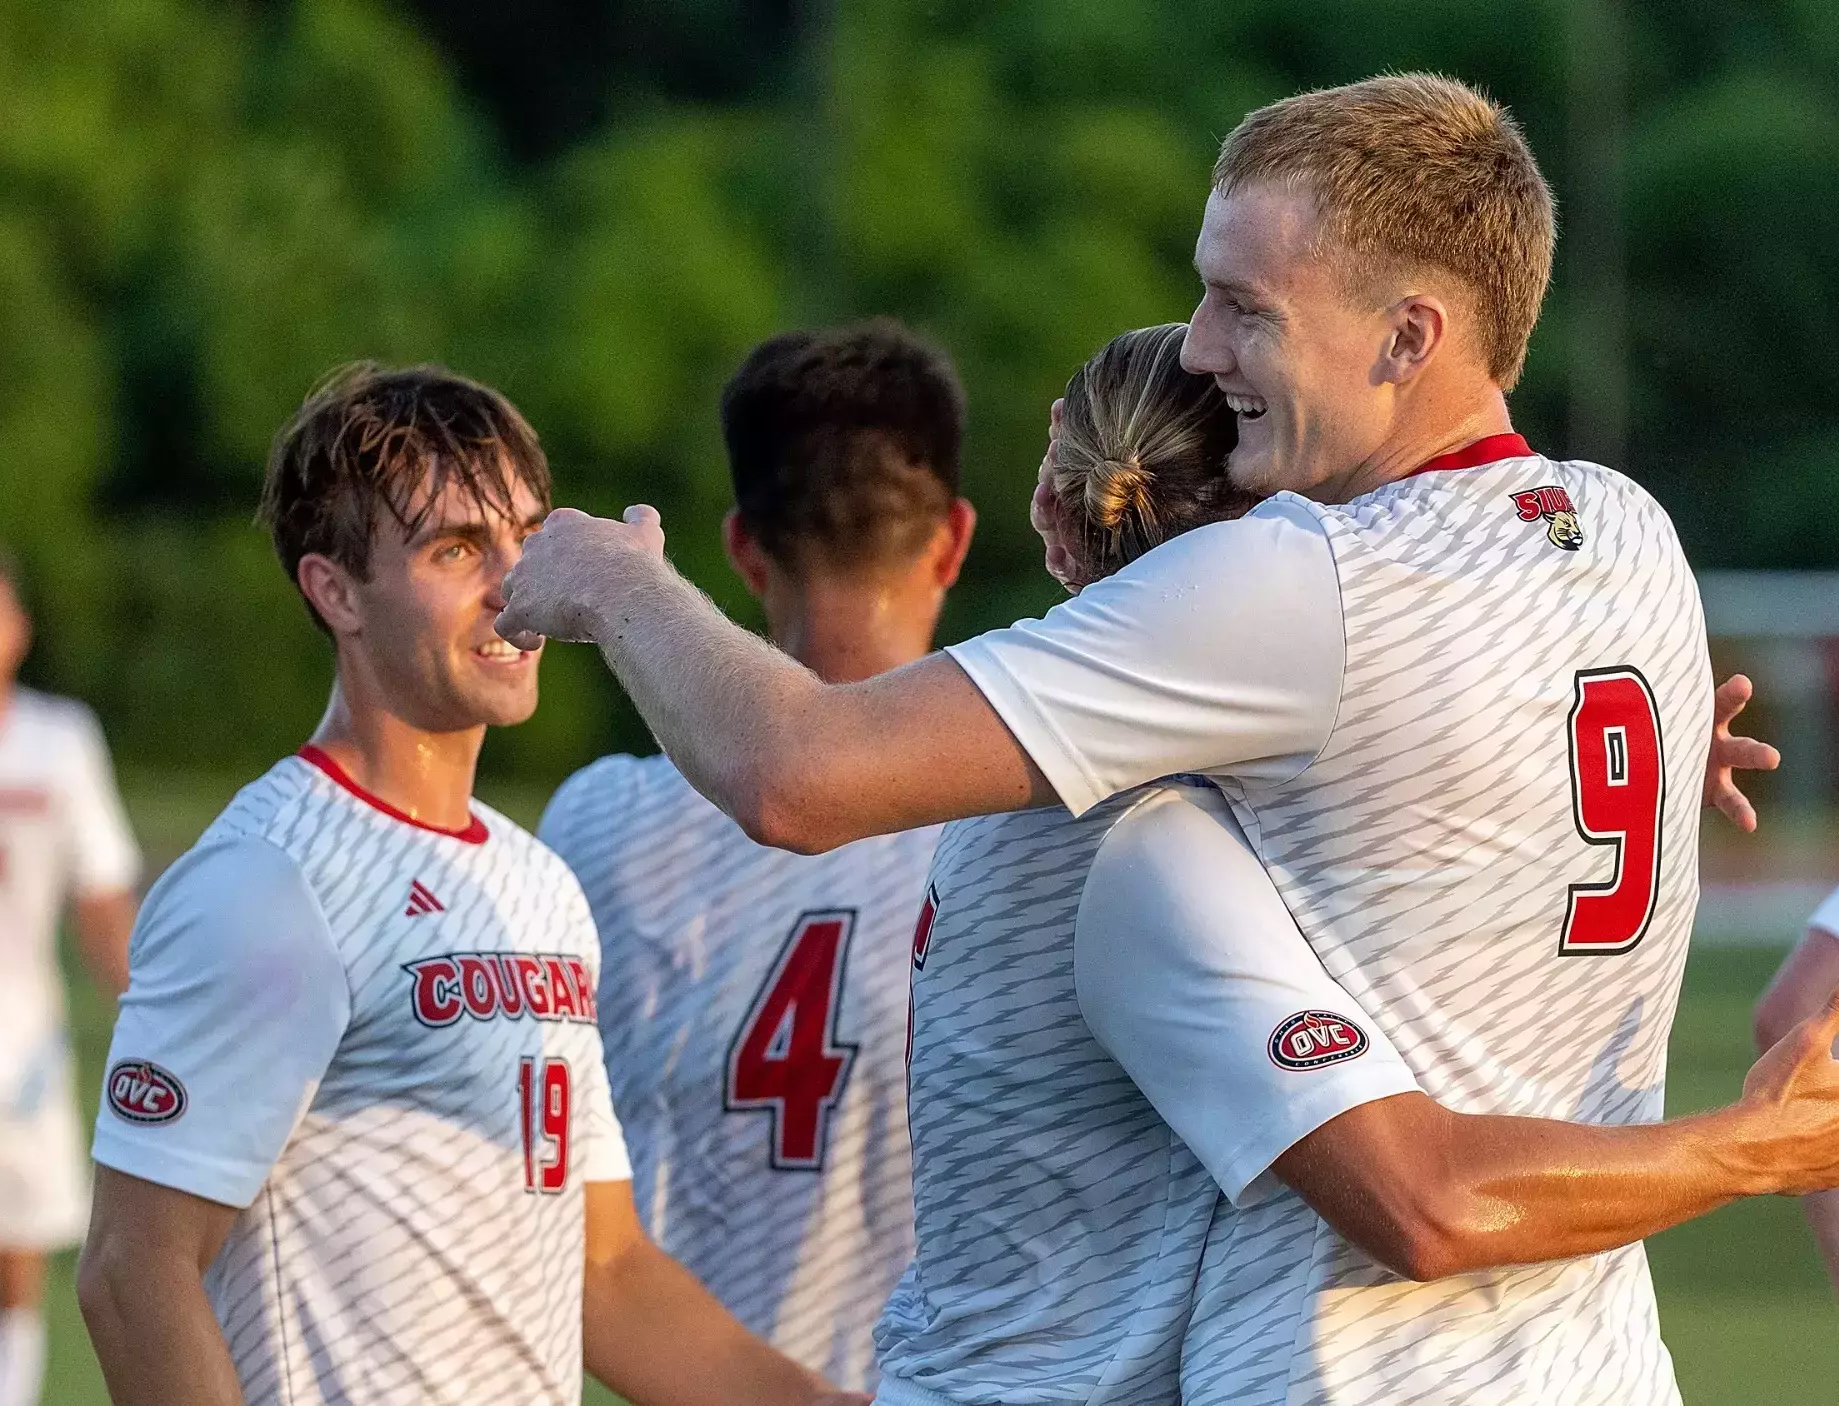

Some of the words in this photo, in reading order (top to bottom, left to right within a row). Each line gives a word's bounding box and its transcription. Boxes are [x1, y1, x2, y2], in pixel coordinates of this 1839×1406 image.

[1558, 664, 1666, 958] 9
[114, 1073, 168, 1113] OVC
[723, 905, 859, 1172] 4
[1289, 1023, 1352, 1058] OVC
[515, 1055, 572, 1194] 19
